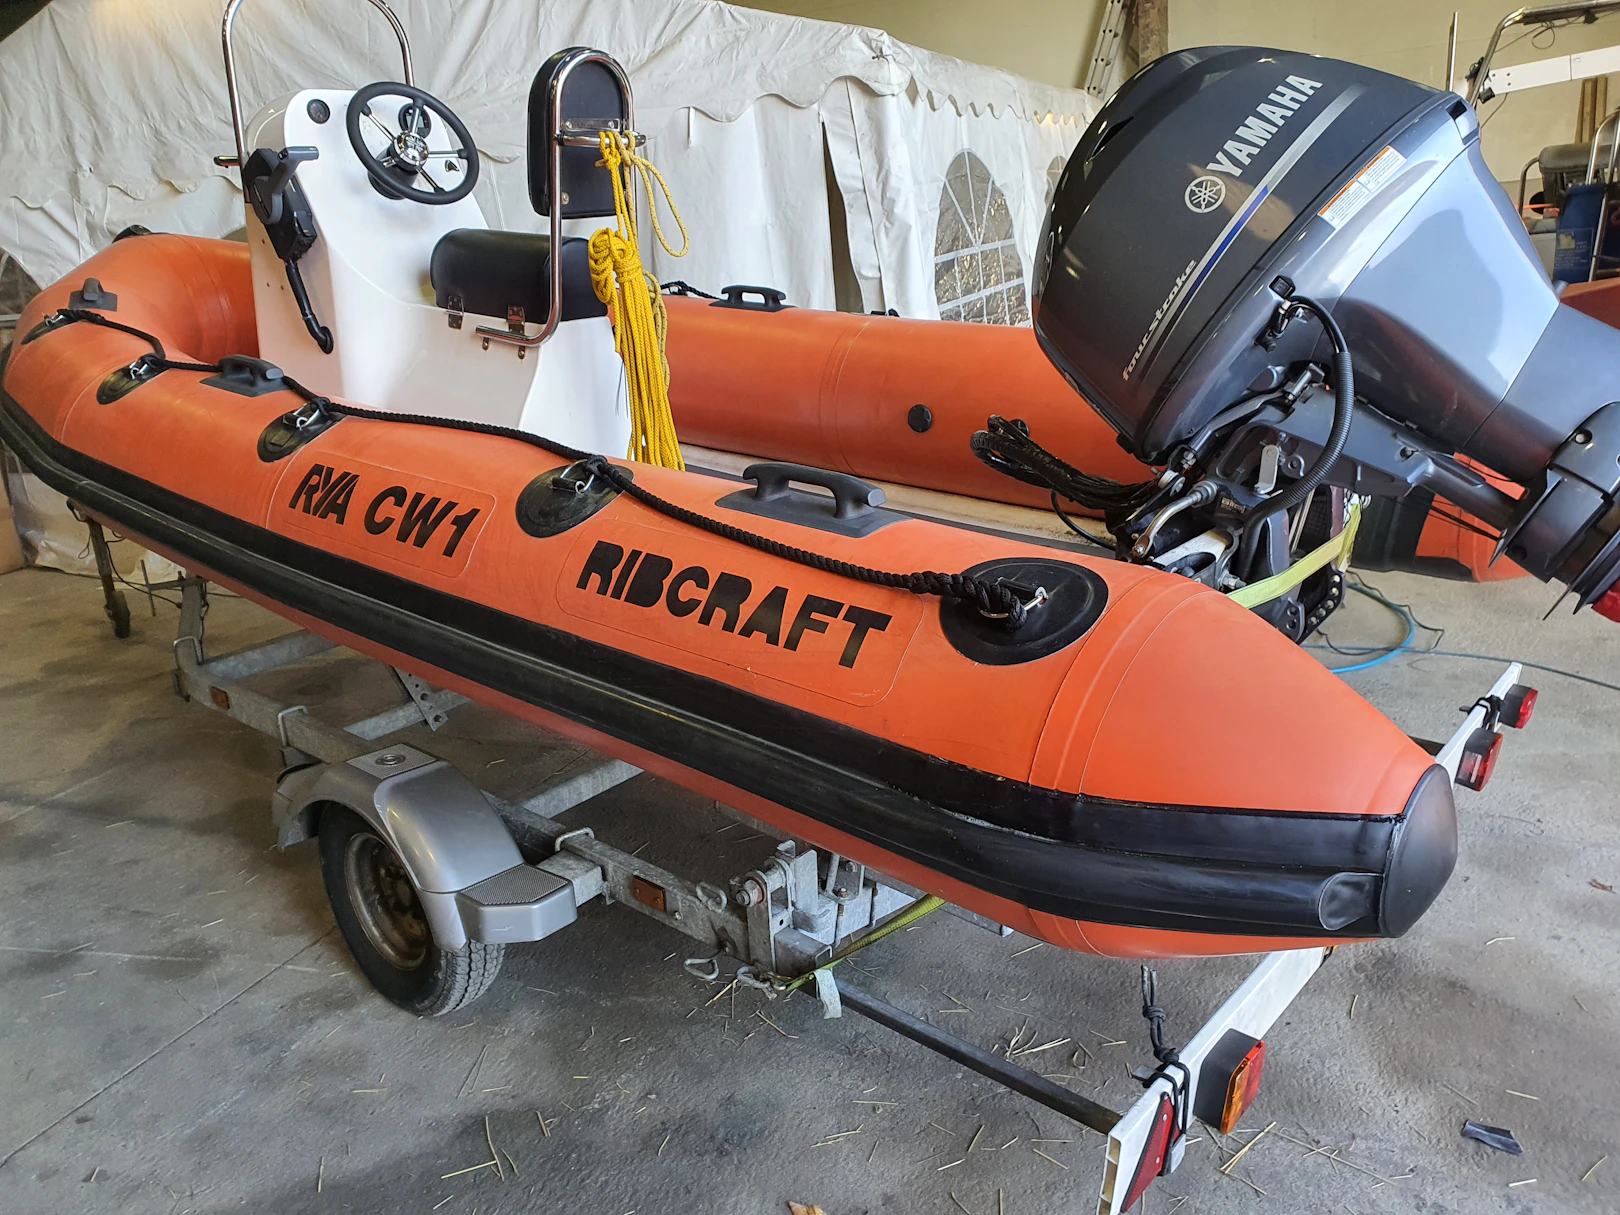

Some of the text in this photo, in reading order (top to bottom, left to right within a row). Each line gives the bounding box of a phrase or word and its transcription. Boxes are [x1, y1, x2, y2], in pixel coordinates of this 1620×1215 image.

[1206, 74, 1323, 177] YAMAHA
[288, 463, 481, 558] RYA CW1
[576, 540, 893, 669] RIBCRAFT
